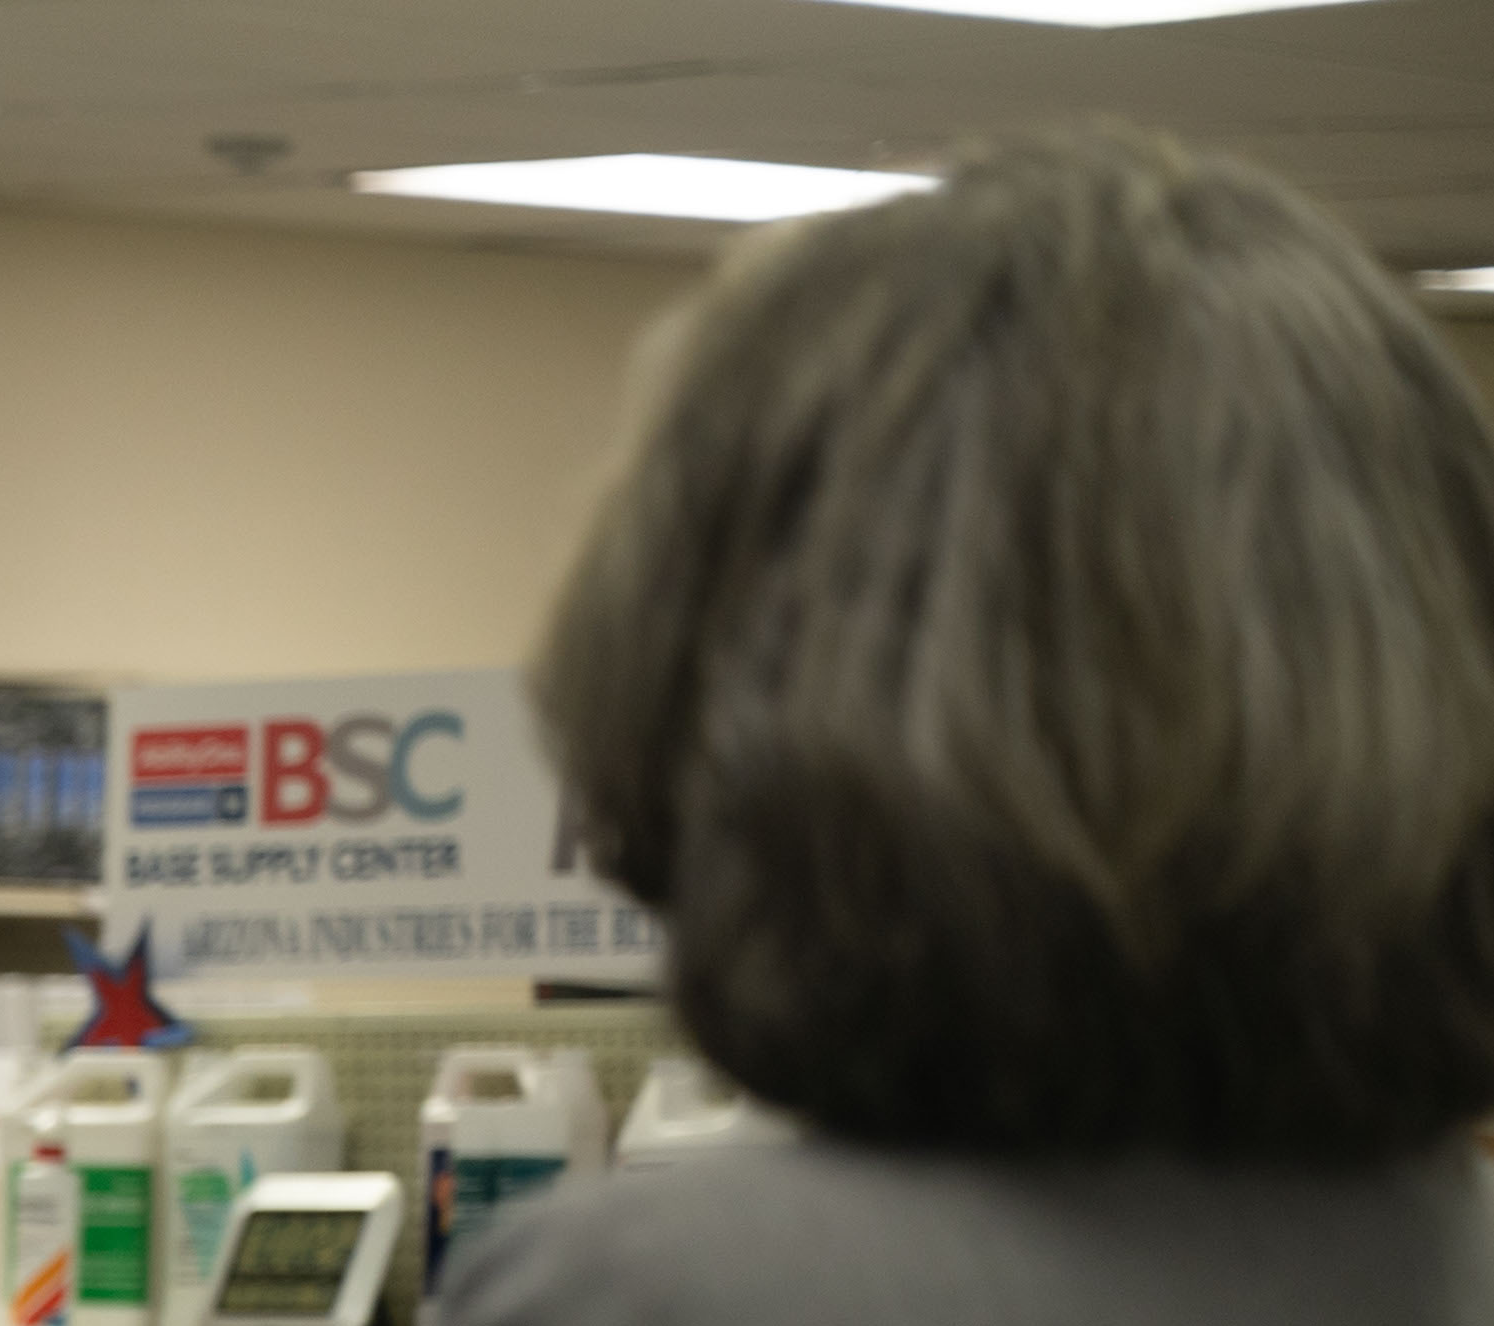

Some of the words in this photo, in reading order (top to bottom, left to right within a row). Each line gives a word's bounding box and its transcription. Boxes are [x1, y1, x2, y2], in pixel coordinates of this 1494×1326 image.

[260, 708, 465, 829] BSC
[124, 847, 201, 889] BASE
[209, 841, 321, 885] SUPPLY
[330, 835, 461, 882] CENTER
[309, 909, 473, 963] INDUSTRIES
[480, 905, 537, 958] FOR
[545, 903, 602, 955] THE
